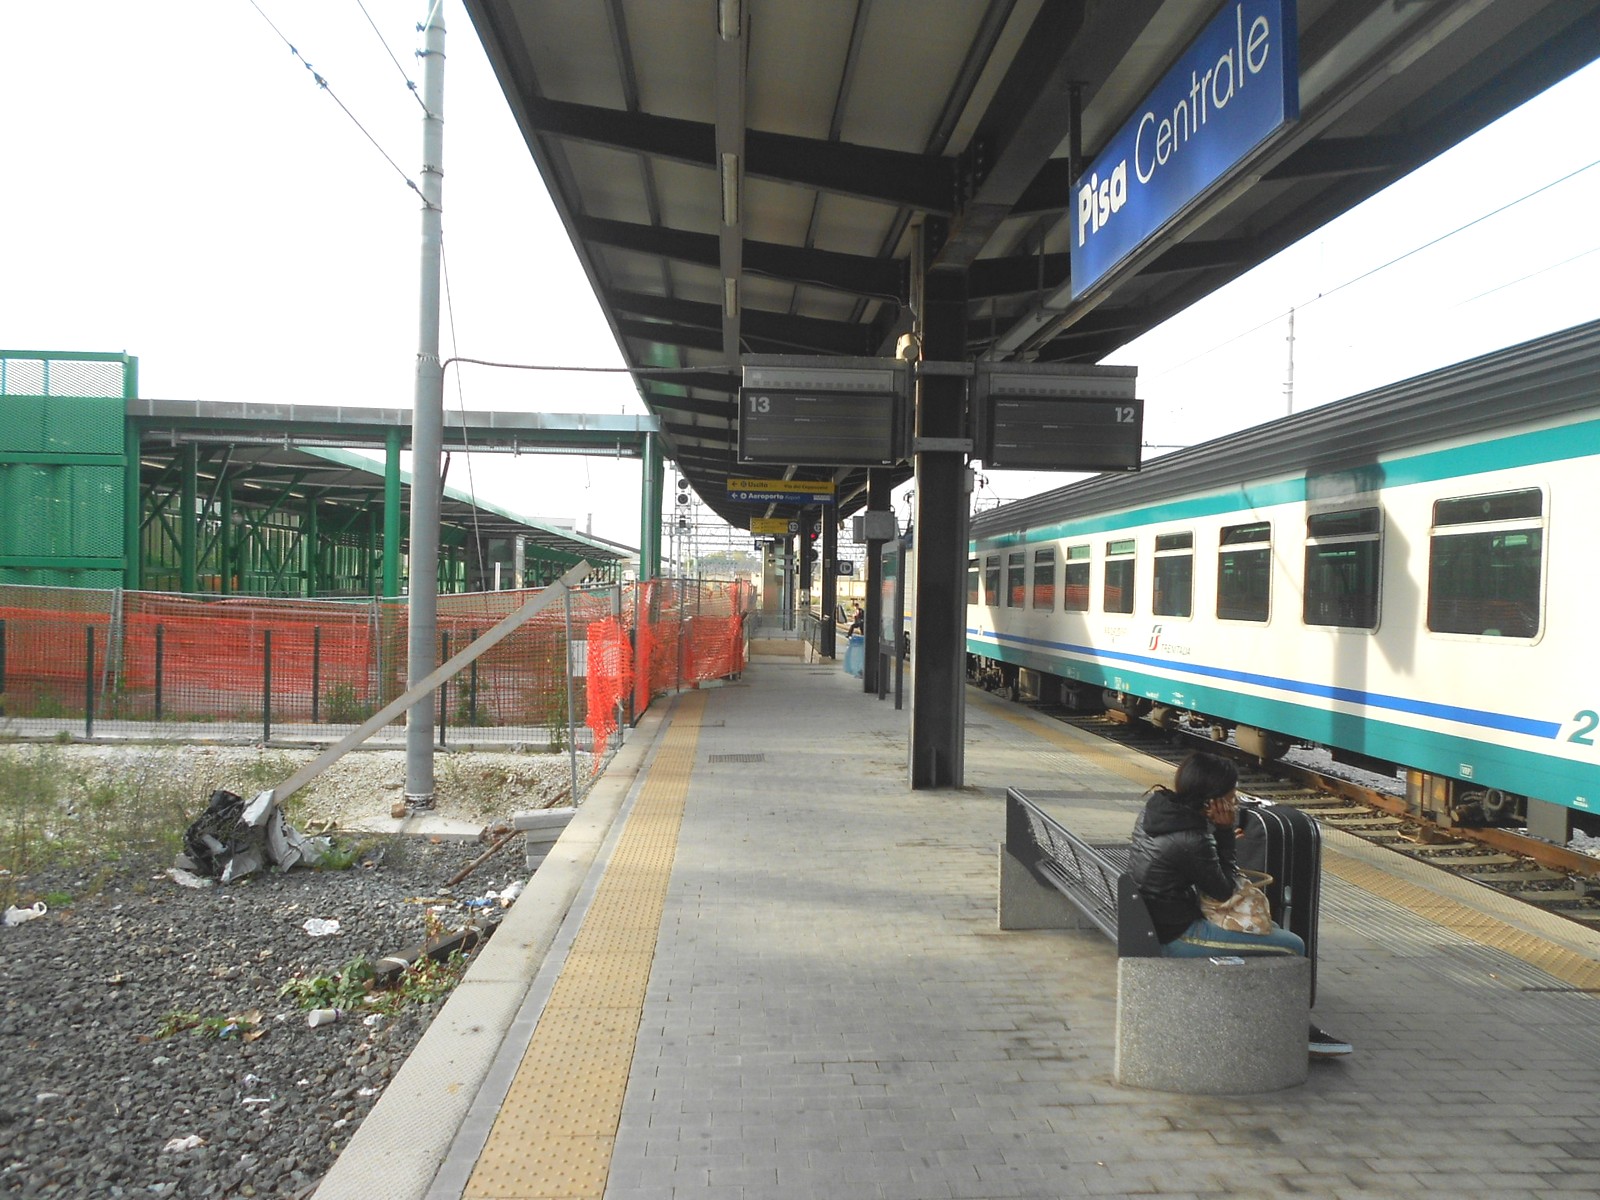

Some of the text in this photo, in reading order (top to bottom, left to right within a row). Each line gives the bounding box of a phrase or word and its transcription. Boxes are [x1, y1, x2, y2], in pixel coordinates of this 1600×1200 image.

[1078, 3, 1270, 248] Pisa Centrale
[748, 396, 771, 413] 13
[1114, 407, 1135, 423] 12
[1566, 709, 1600, 746] 2
